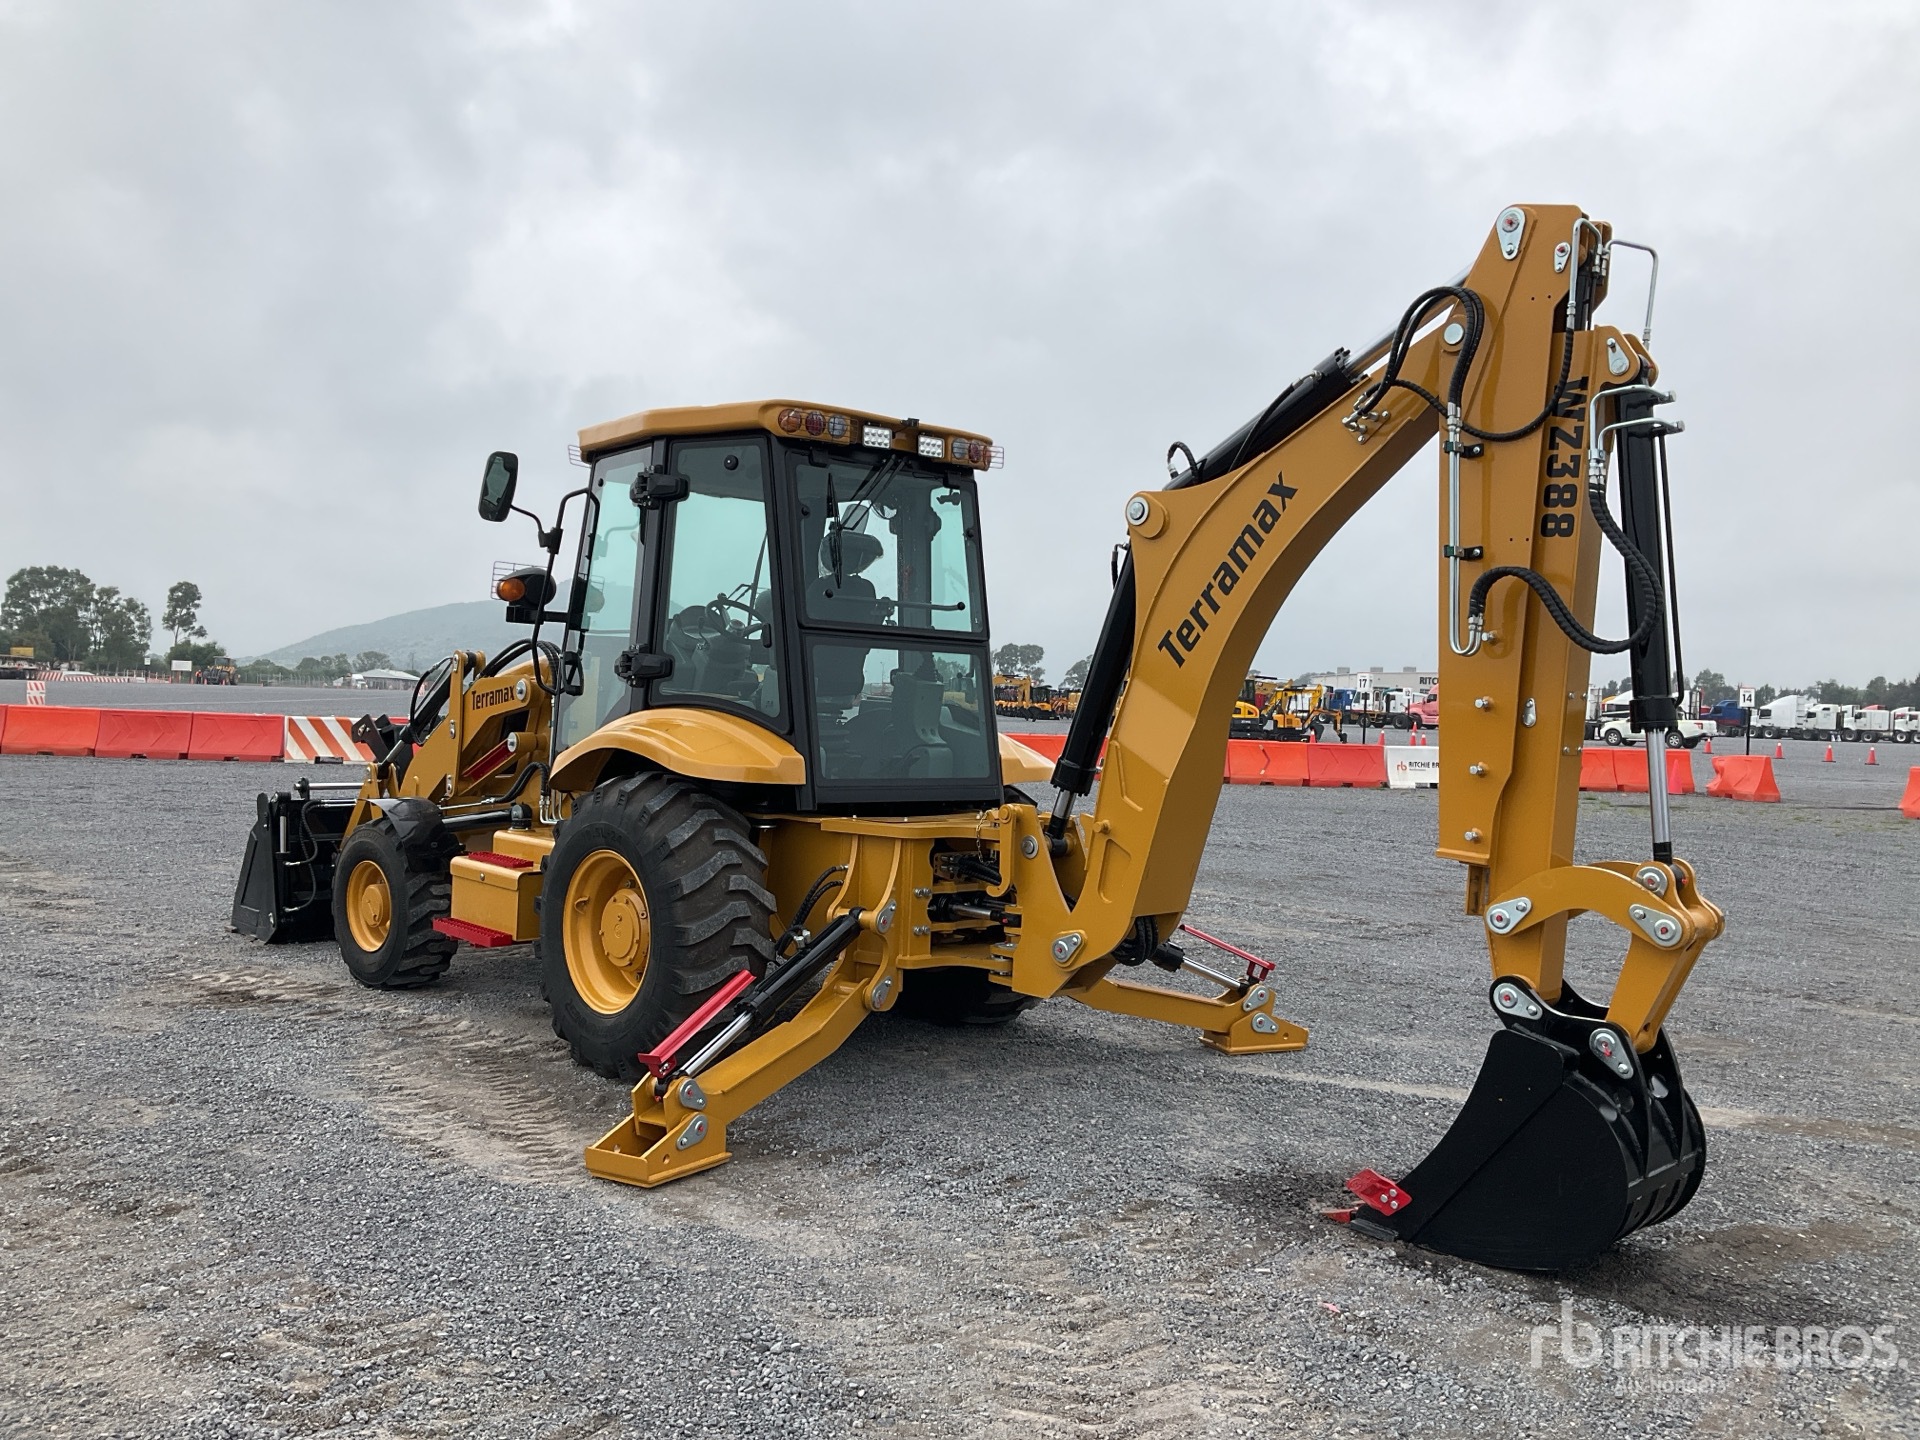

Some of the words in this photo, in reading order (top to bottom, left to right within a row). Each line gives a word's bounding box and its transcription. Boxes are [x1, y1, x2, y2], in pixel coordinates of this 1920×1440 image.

[1157, 470, 1299, 669] Terramax
[1359, 678, 1368, 689] 17
[471, 685, 515, 710] Terramax
[1742, 693, 1752, 702] 14
